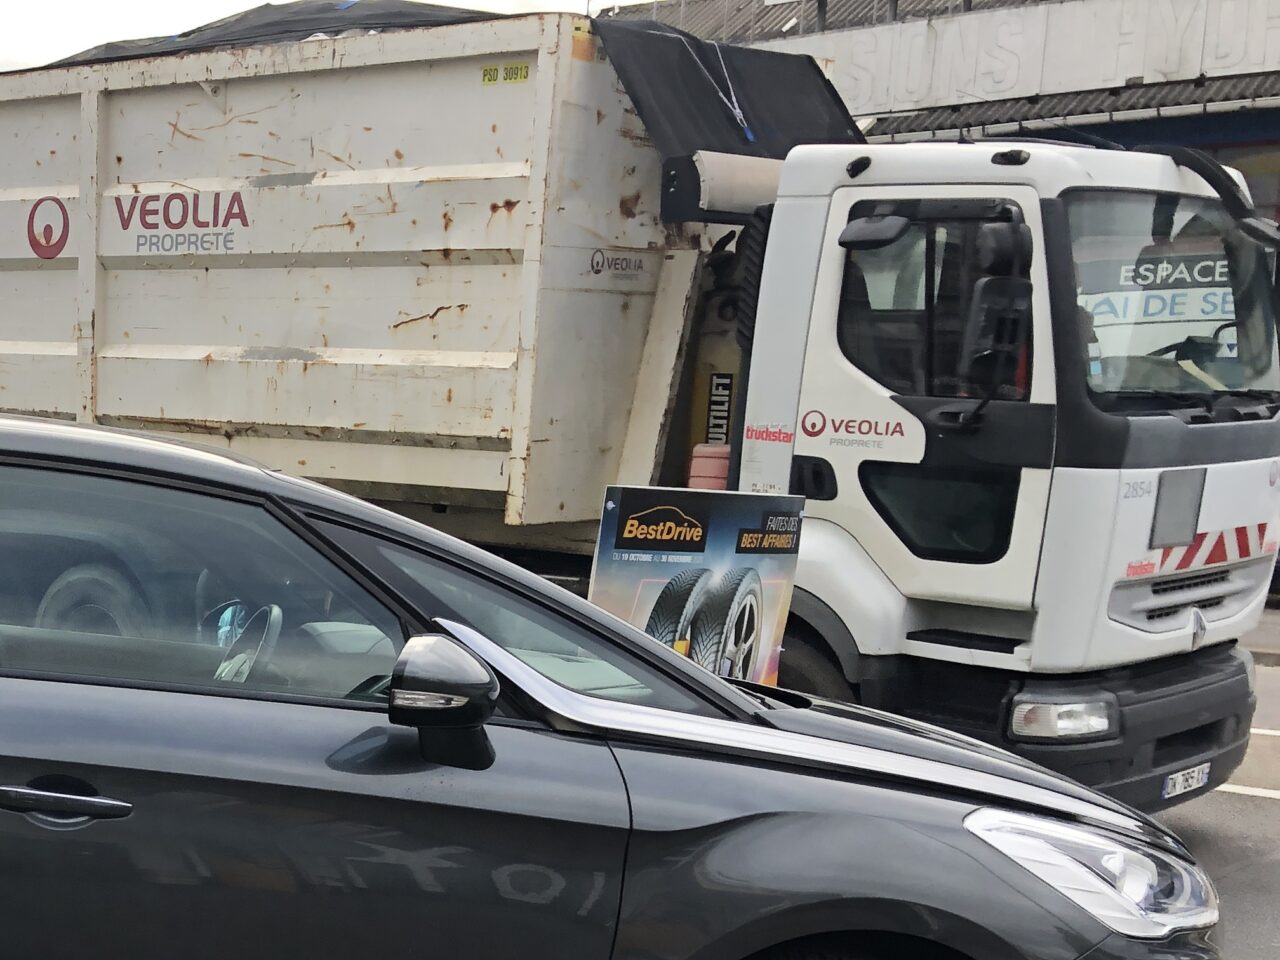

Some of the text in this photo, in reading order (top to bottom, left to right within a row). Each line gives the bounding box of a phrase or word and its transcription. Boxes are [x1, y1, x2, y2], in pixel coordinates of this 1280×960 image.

[482, 65, 529, 82] PSD 30913
[114, 191, 249, 231] VEOLIA
[606, 257, 644, 272] VEOLIA
[1119, 260, 1229, 285] ESPACE
[1142, 293, 1188, 318] DE
[746, 425, 794, 443] truckstar
[831, 418, 905, 437] VEOLIA
[1123, 480, 1153, 499] 2854
[623, 518, 703, 542] BestDrive
[740, 533, 763, 548] BEST
